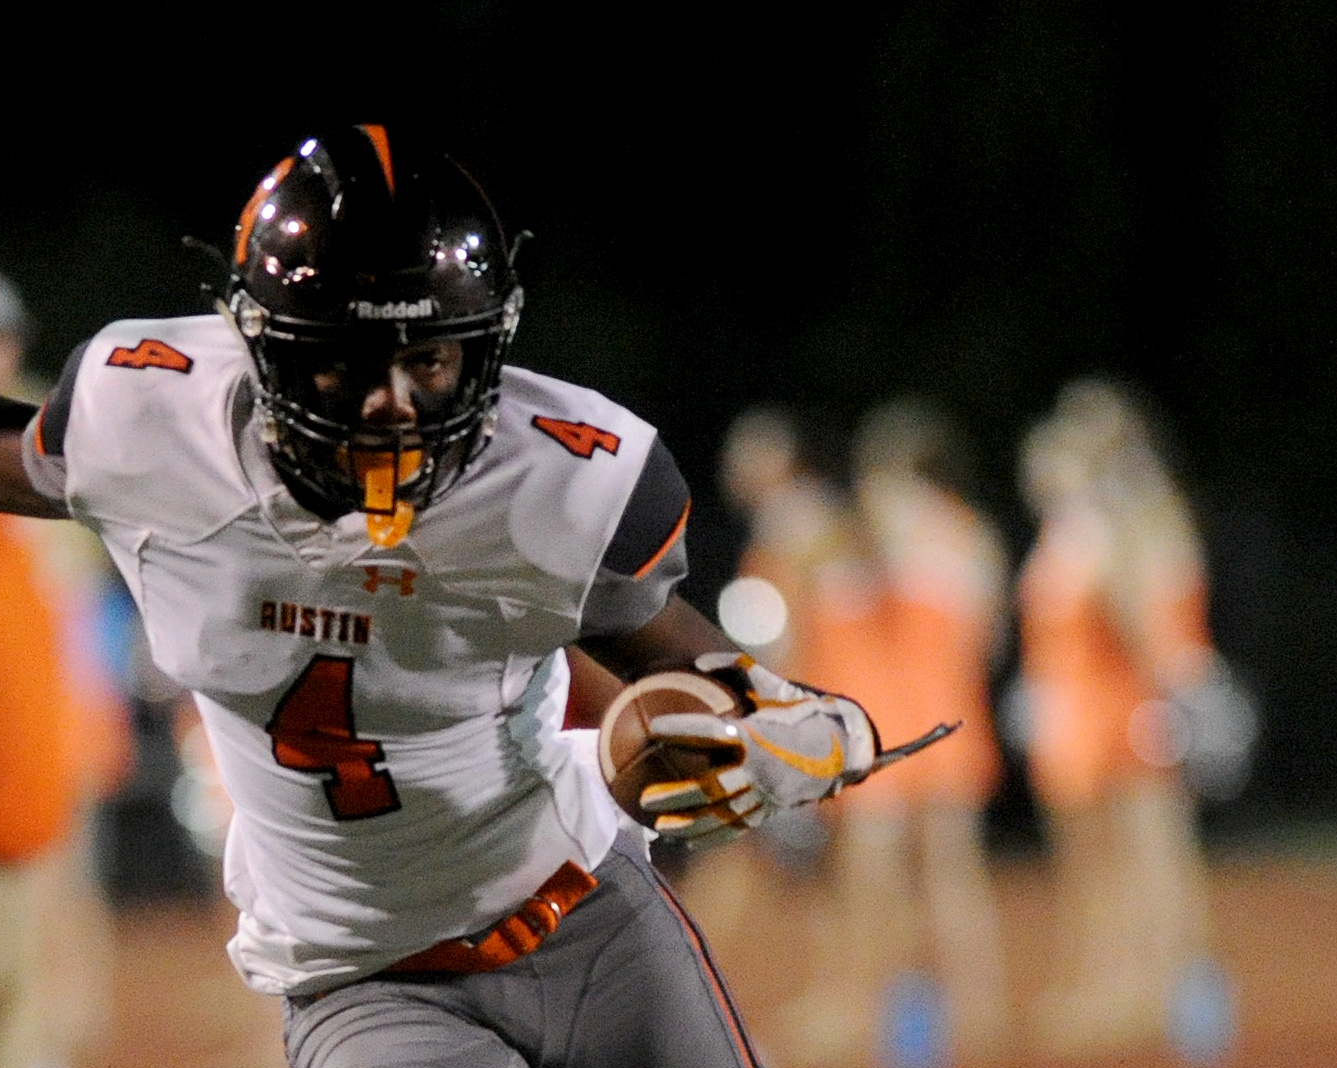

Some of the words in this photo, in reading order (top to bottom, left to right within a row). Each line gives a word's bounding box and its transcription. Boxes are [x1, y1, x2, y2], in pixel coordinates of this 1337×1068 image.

[356, 299, 433, 320] Riddell
[105, 338, 194, 375] 4
[530, 414, 621, 460] 4
[261, 600, 371, 645] AUSTIN
[266, 653, 402, 821] 4
